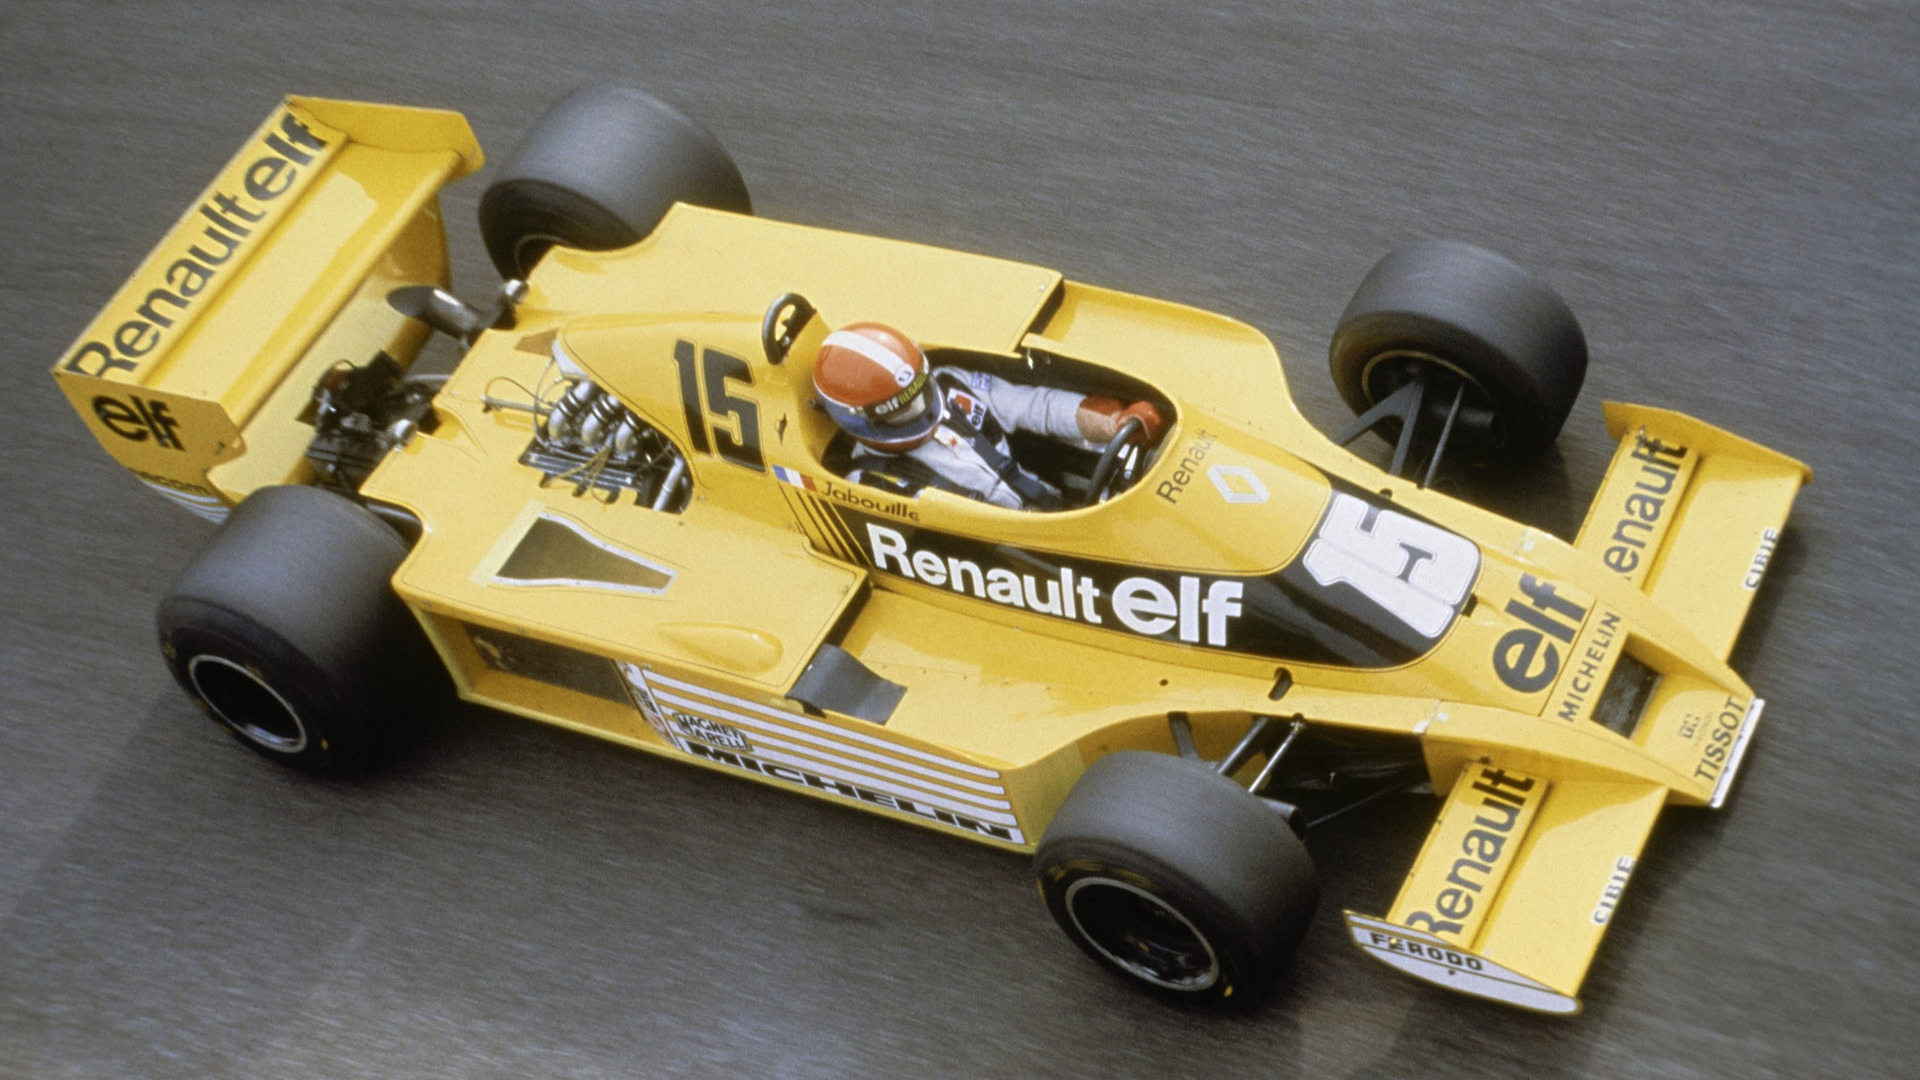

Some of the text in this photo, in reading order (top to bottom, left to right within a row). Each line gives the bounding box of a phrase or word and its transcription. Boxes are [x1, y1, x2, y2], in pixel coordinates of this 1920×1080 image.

[64, 191, 267, 377] Renault
[244, 112, 328, 202] elf
[91, 393, 185, 451] elf
[673, 338, 767, 472] 15
[875, 397, 899, 415] elf
[971, 403, 984, 426] elf
[820, 480, 920, 522] Jabouille
[1155, 430, 1216, 505] Renault
[1603, 434, 1689, 579] enault
[866, 521, 1244, 646] Renault elf
[1302, 492, 1481, 639] 15
[1744, 529, 1779, 590] CIBIE
[1492, 572, 1592, 694] elf
[1557, 610, 1622, 723] MICHELIN
[1693, 695, 1745, 781] TISSOT
[687, 741, 1013, 841] MICHELIN
[1593, 856, 1634, 925] CIBIE
[1370, 932, 1484, 972] FERODO
